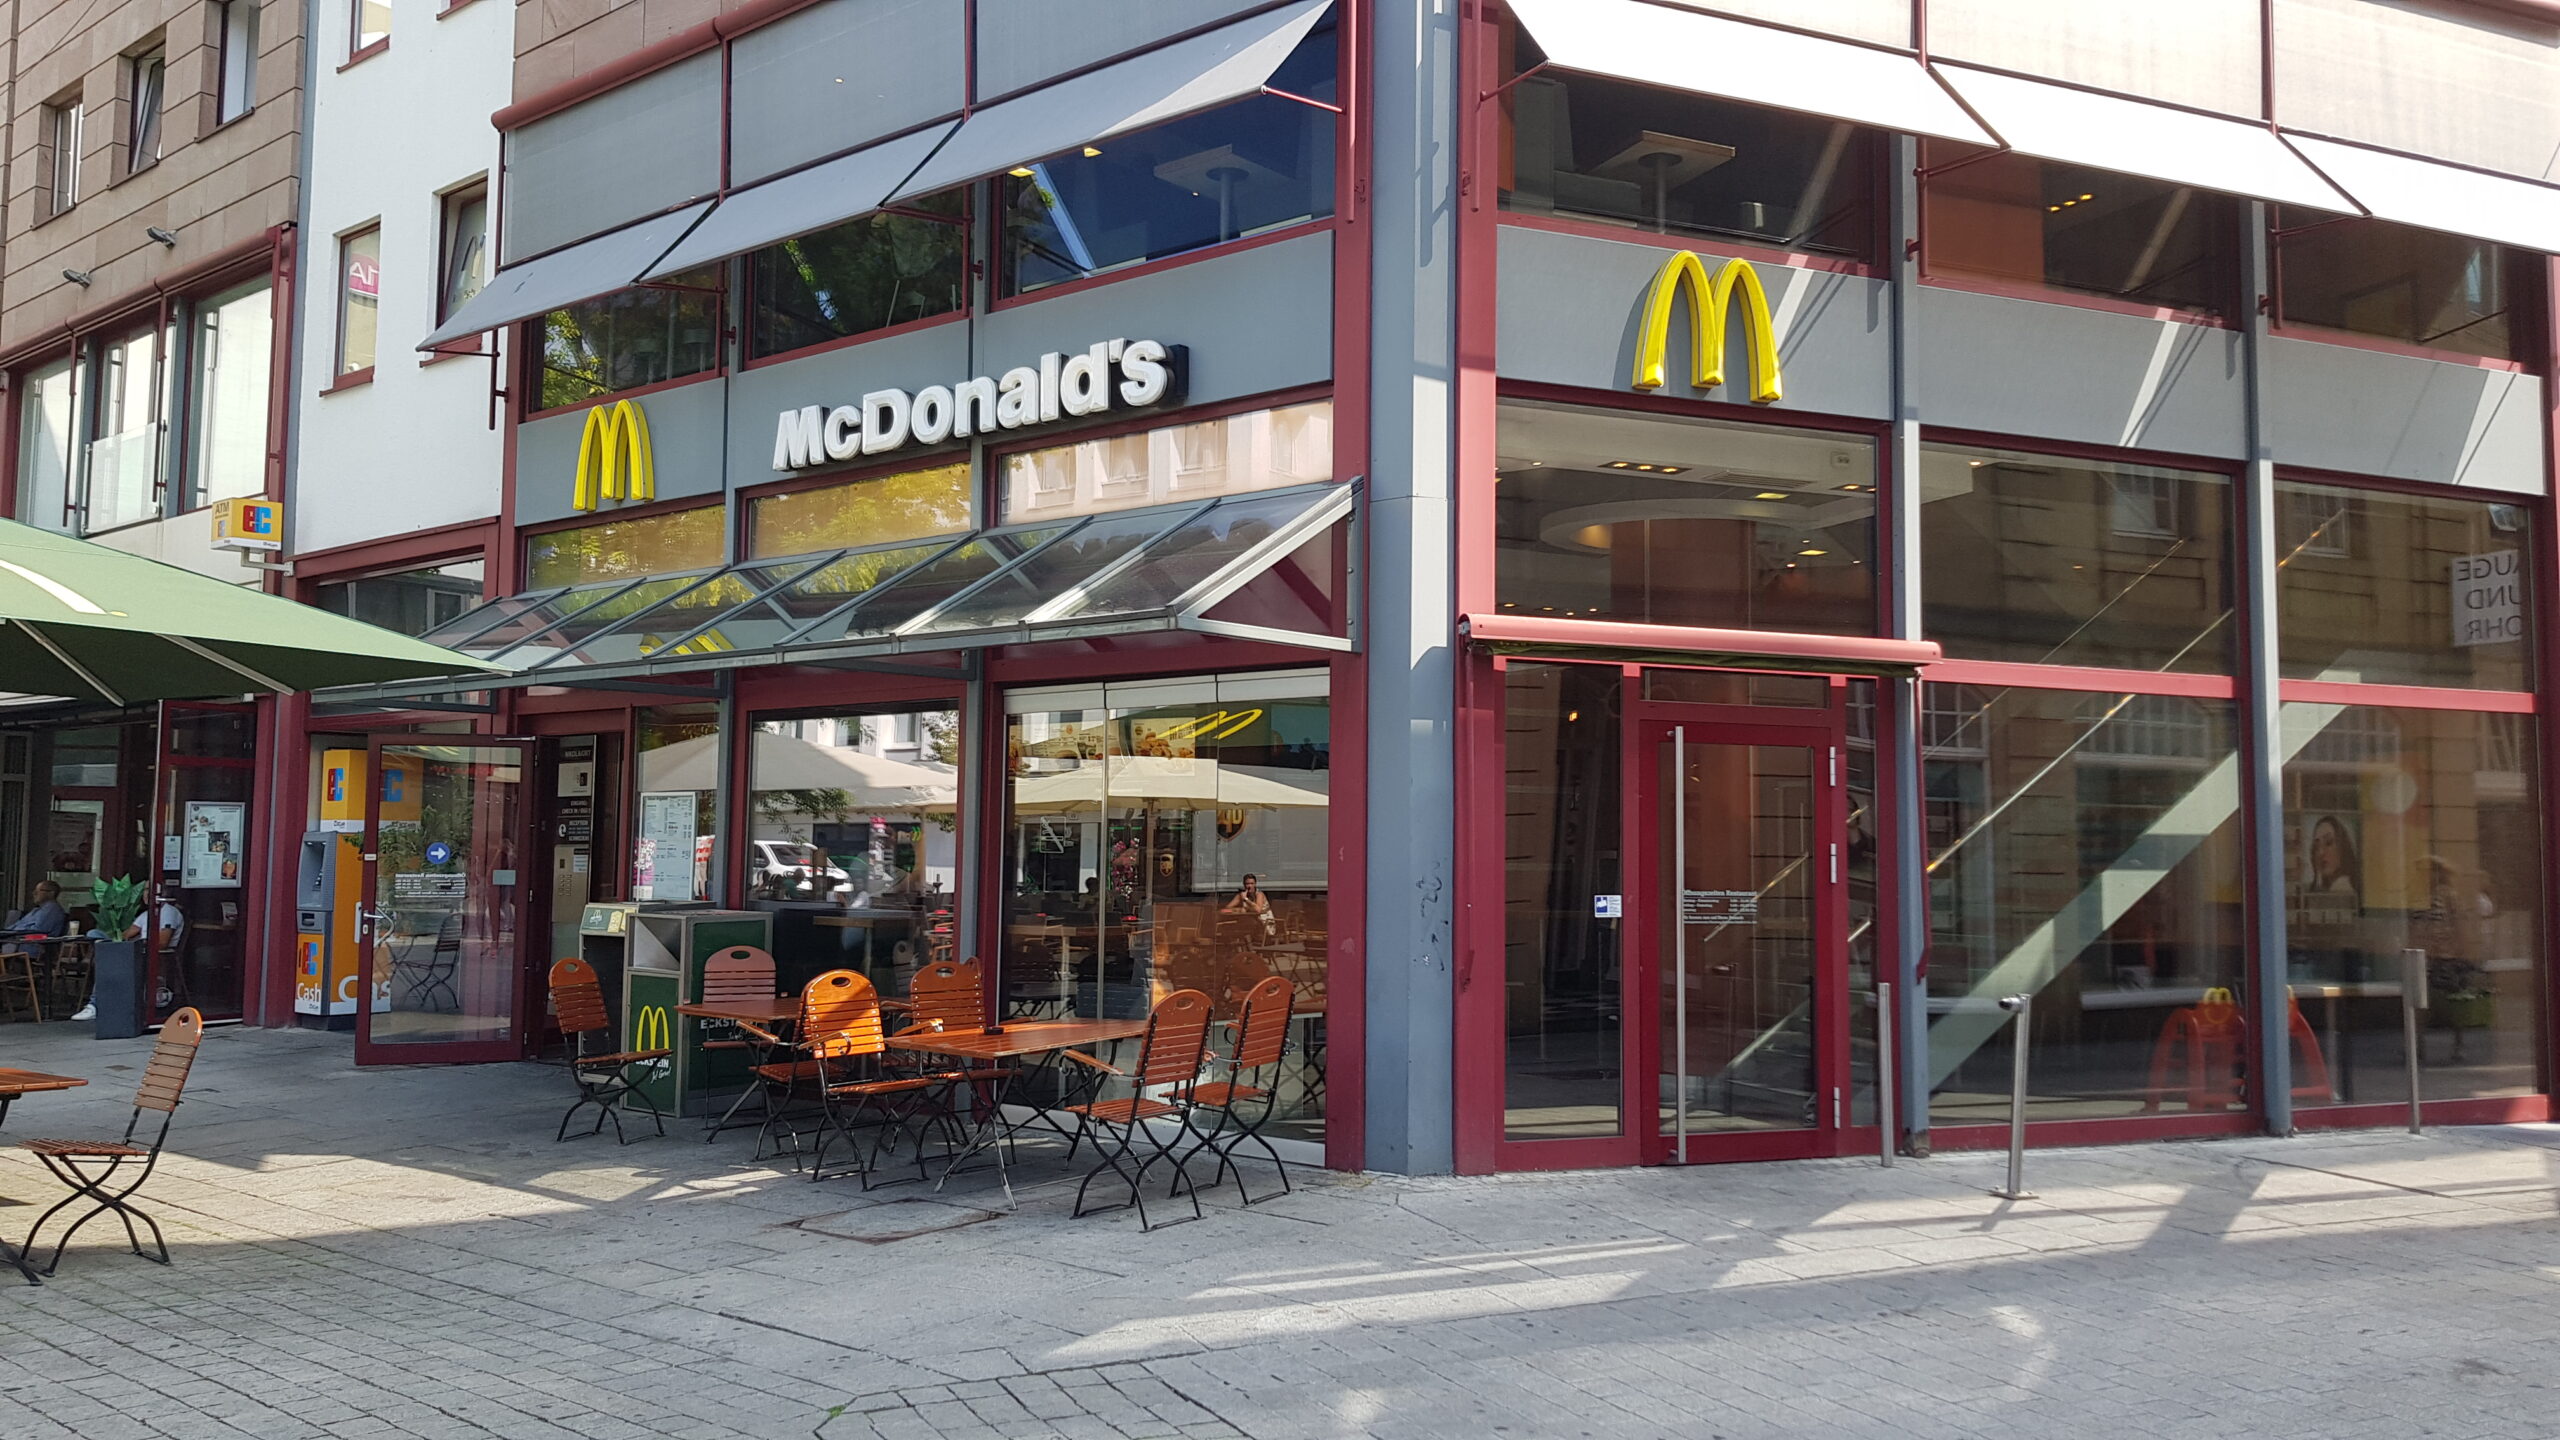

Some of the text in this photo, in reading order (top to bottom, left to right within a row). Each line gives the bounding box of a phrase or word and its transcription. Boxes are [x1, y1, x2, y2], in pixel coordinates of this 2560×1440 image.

[772, 338, 1171, 471] McDonald's
[215, 502, 230, 515] ATM
[297, 982, 321, 1002] Cash
